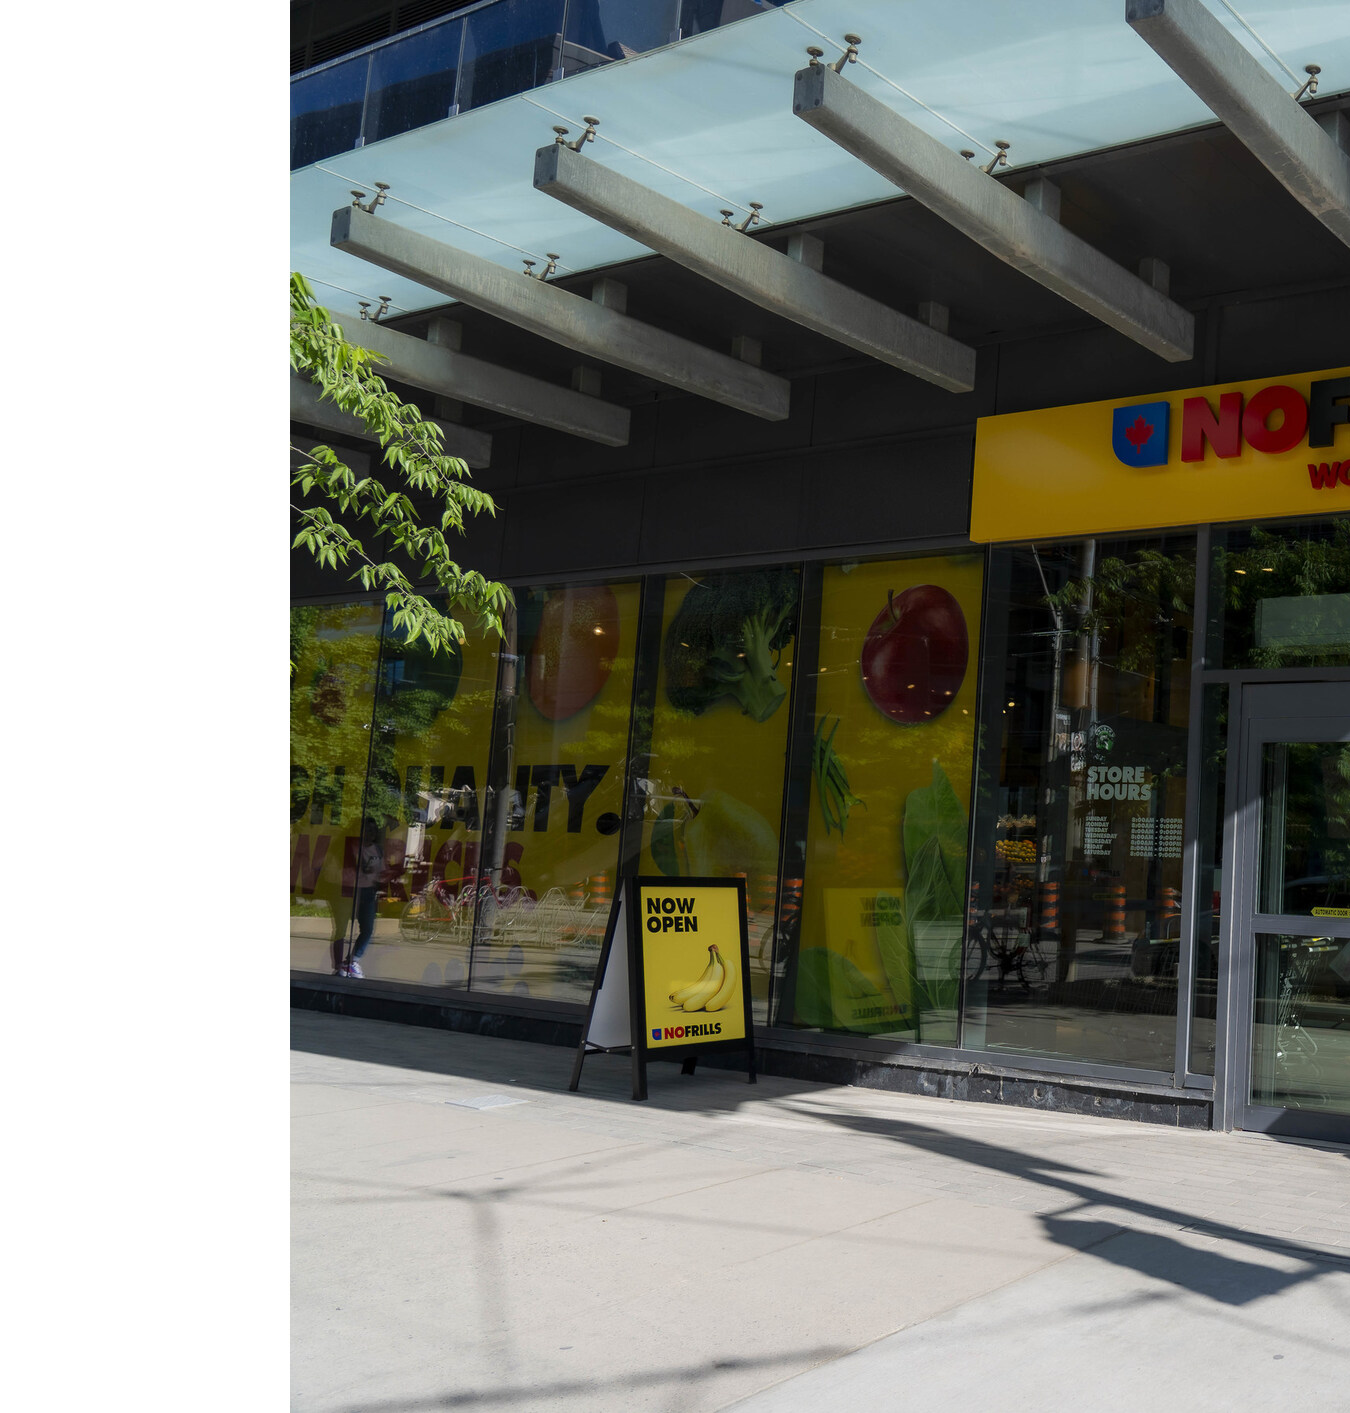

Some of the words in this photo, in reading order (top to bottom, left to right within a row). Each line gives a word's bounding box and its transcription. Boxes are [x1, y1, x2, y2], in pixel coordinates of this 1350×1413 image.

[1087, 766, 1145, 783] STORE
[364, 764, 621, 835] UAITY.
[1086, 783, 1152, 801] HOURS
[647, 898, 695, 914] NOW
[647, 916, 698, 933] OPEN
